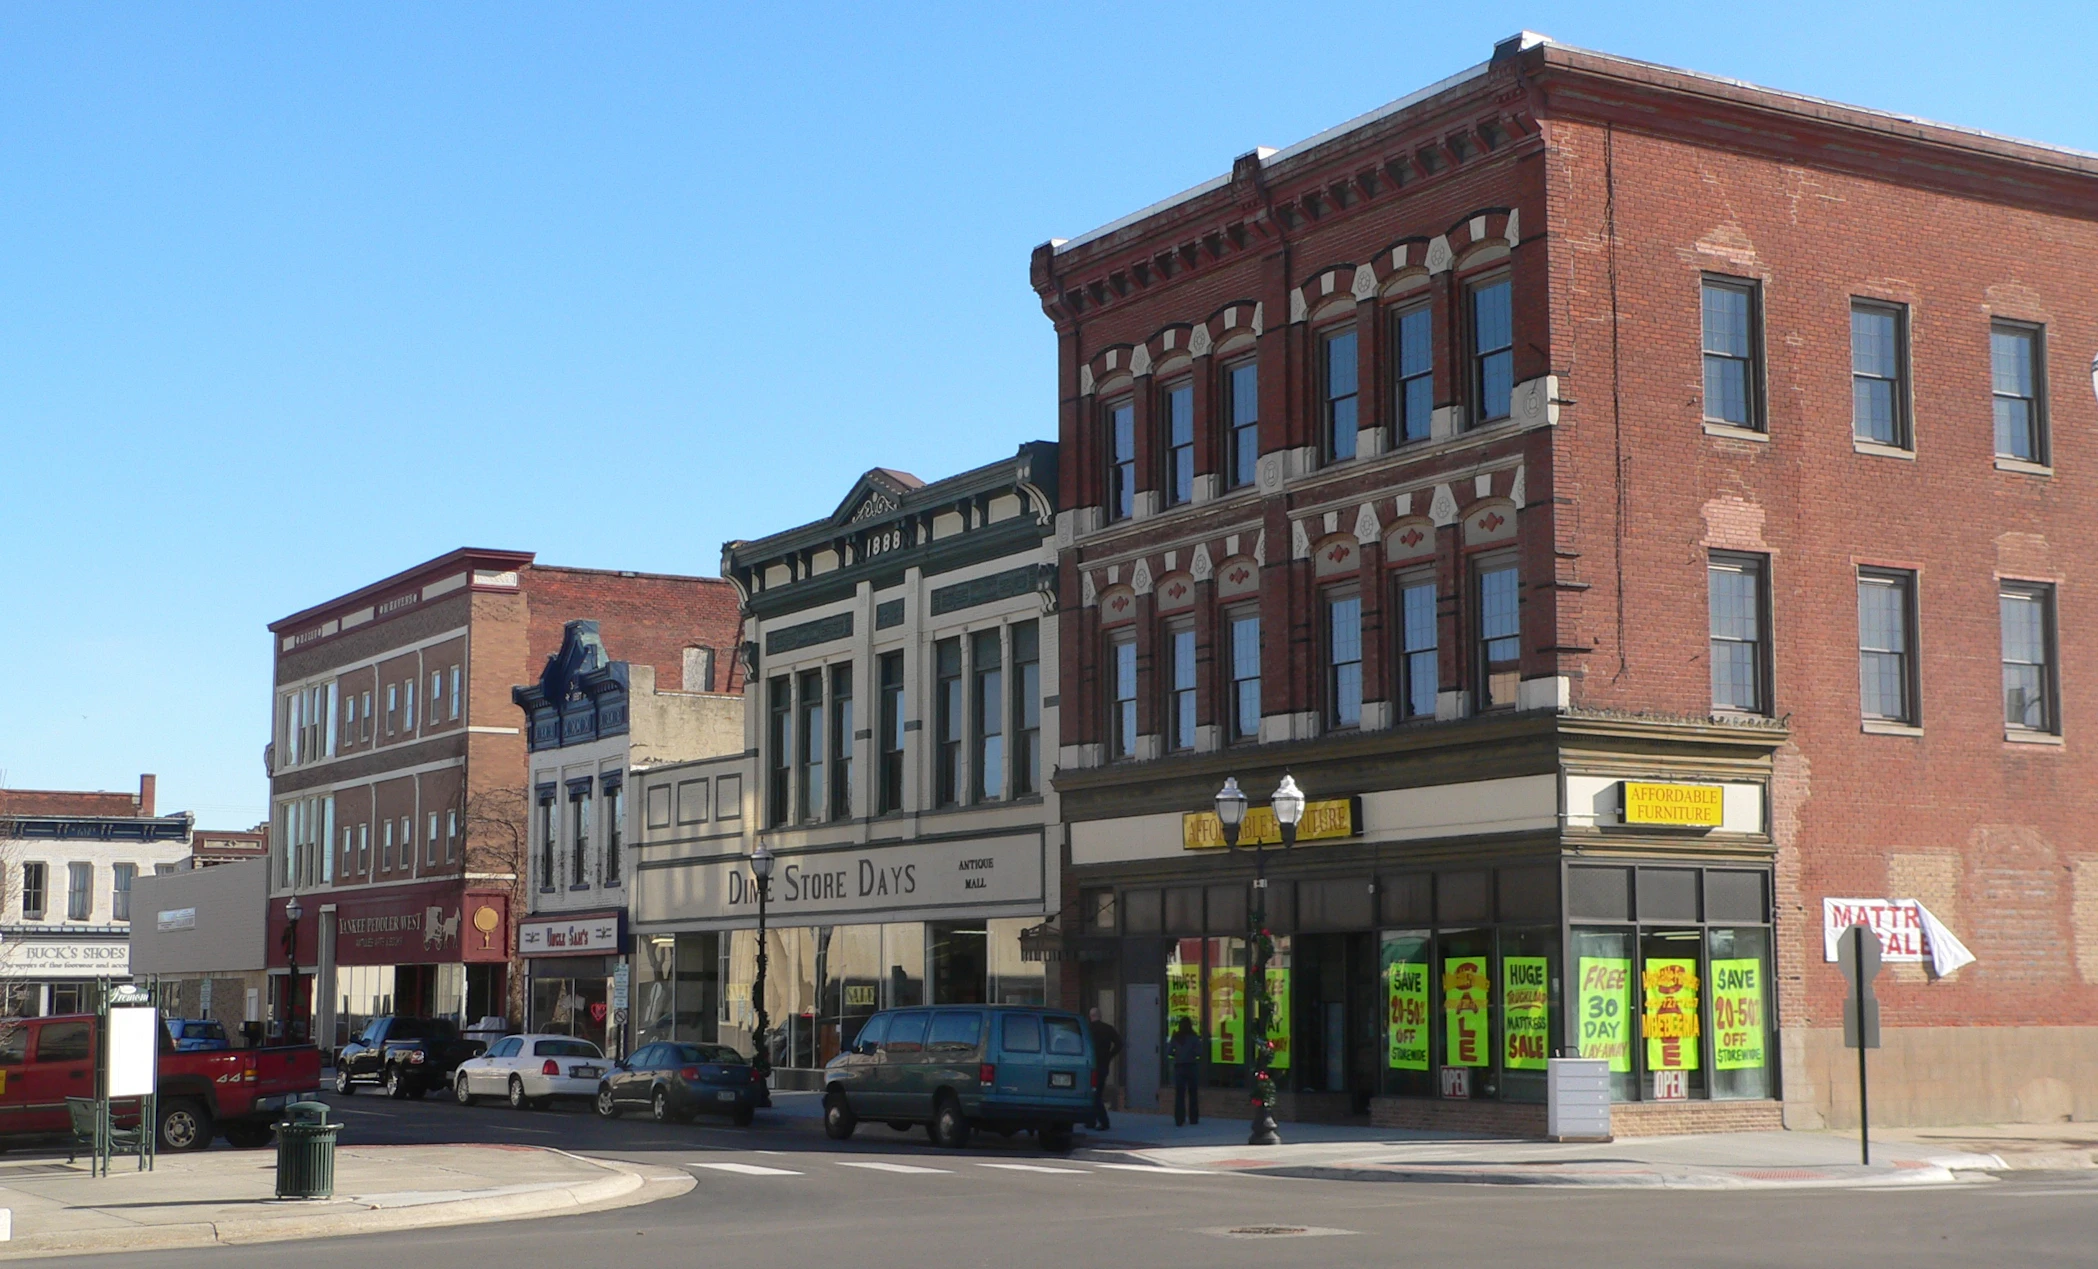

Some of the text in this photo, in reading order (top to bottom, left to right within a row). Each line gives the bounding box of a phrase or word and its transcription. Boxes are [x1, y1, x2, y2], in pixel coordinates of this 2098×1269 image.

[866, 530, 901, 558] 1888
[1631, 788, 1718, 804] AFFORDABLE
[1188, 806, 1346, 842] AFFOBLE FNITURE
[1637, 805, 1711, 821] FURNITURE
[958, 858, 994, 871] ANTIQUE
[785, 864, 847, 901] STORE
[858, 859, 916, 897] DAYS
[965, 879, 987, 889] MALL
[340, 912, 421, 934] YANKEE PEDDLER WEST
[1833, 906, 1920, 928] MATTR
[546, 925, 589, 947] UNCLE SAM'S
[26, 945, 126, 960] BUCK'S SHOES
[1394, 971, 1422, 993] SAVE
[1510, 964, 1543, 986] HUGE
[1583, 966, 1627, 991] FREE
[1716, 968, 1756, 990] SAVE
[1588, 995, 1618, 1019] 30
[1396, 1028, 1416, 1044] OFF
[1584, 1020, 1620, 1039] DAY
[1722, 1032, 1748, 1047] OFF
[1508, 1033, 1544, 1060] SALE
[1443, 1068, 1469, 1095] OPEN
[1655, 1071, 1688, 1099] OPEN
